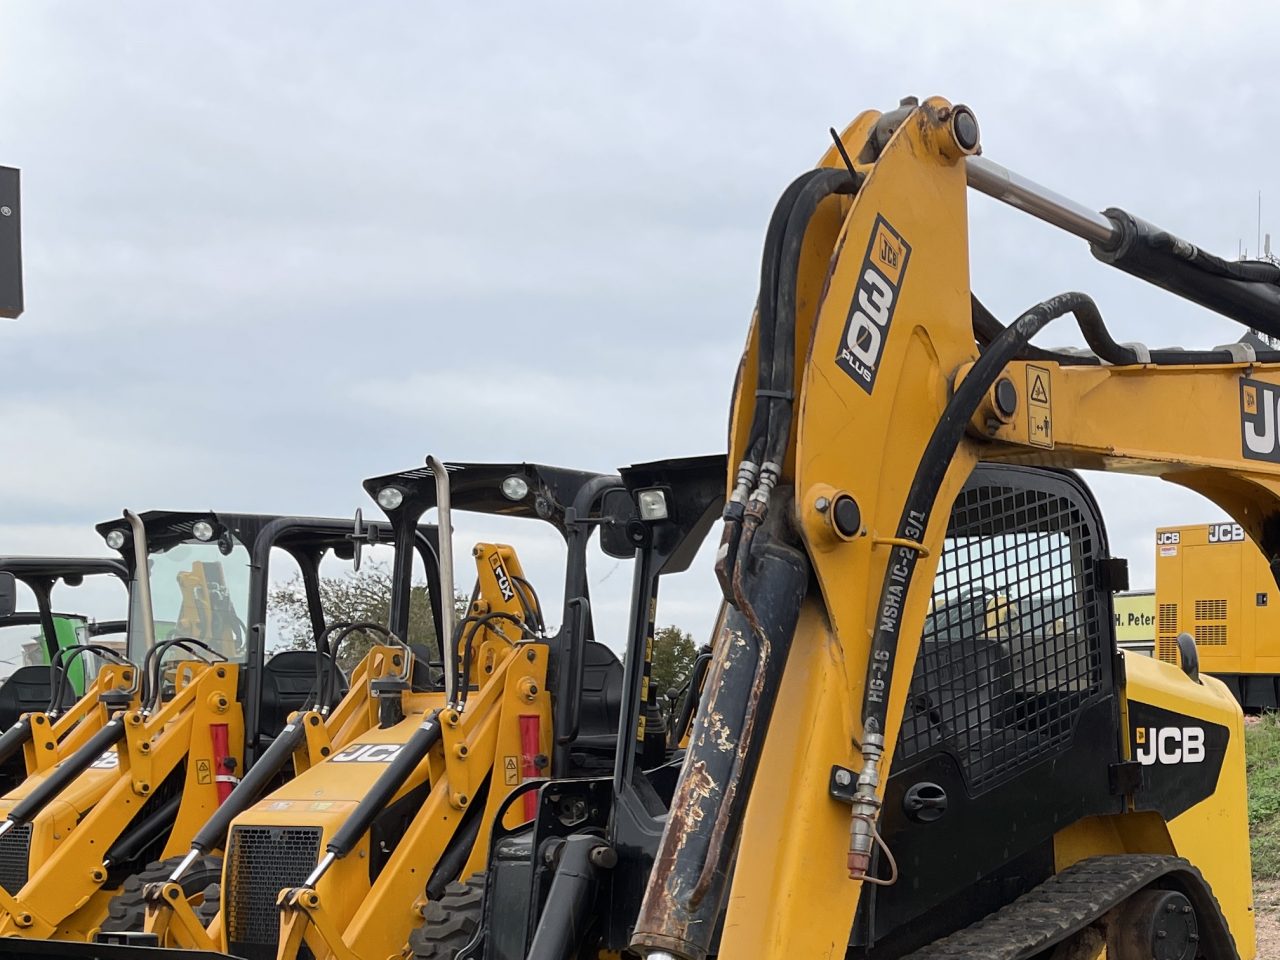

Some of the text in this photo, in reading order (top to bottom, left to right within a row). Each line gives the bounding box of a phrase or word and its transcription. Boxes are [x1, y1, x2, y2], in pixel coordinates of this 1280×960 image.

[880, 239, 899, 268] JCB
[841, 348, 873, 383] PLUS
[891, 509, 926, 583] IC-23/1
[1157, 532, 1180, 545] JCB
[1208, 524, 1245, 542] JCB
[880, 585, 905, 632] MSHA
[1136, 727, 1206, 765] JCB
